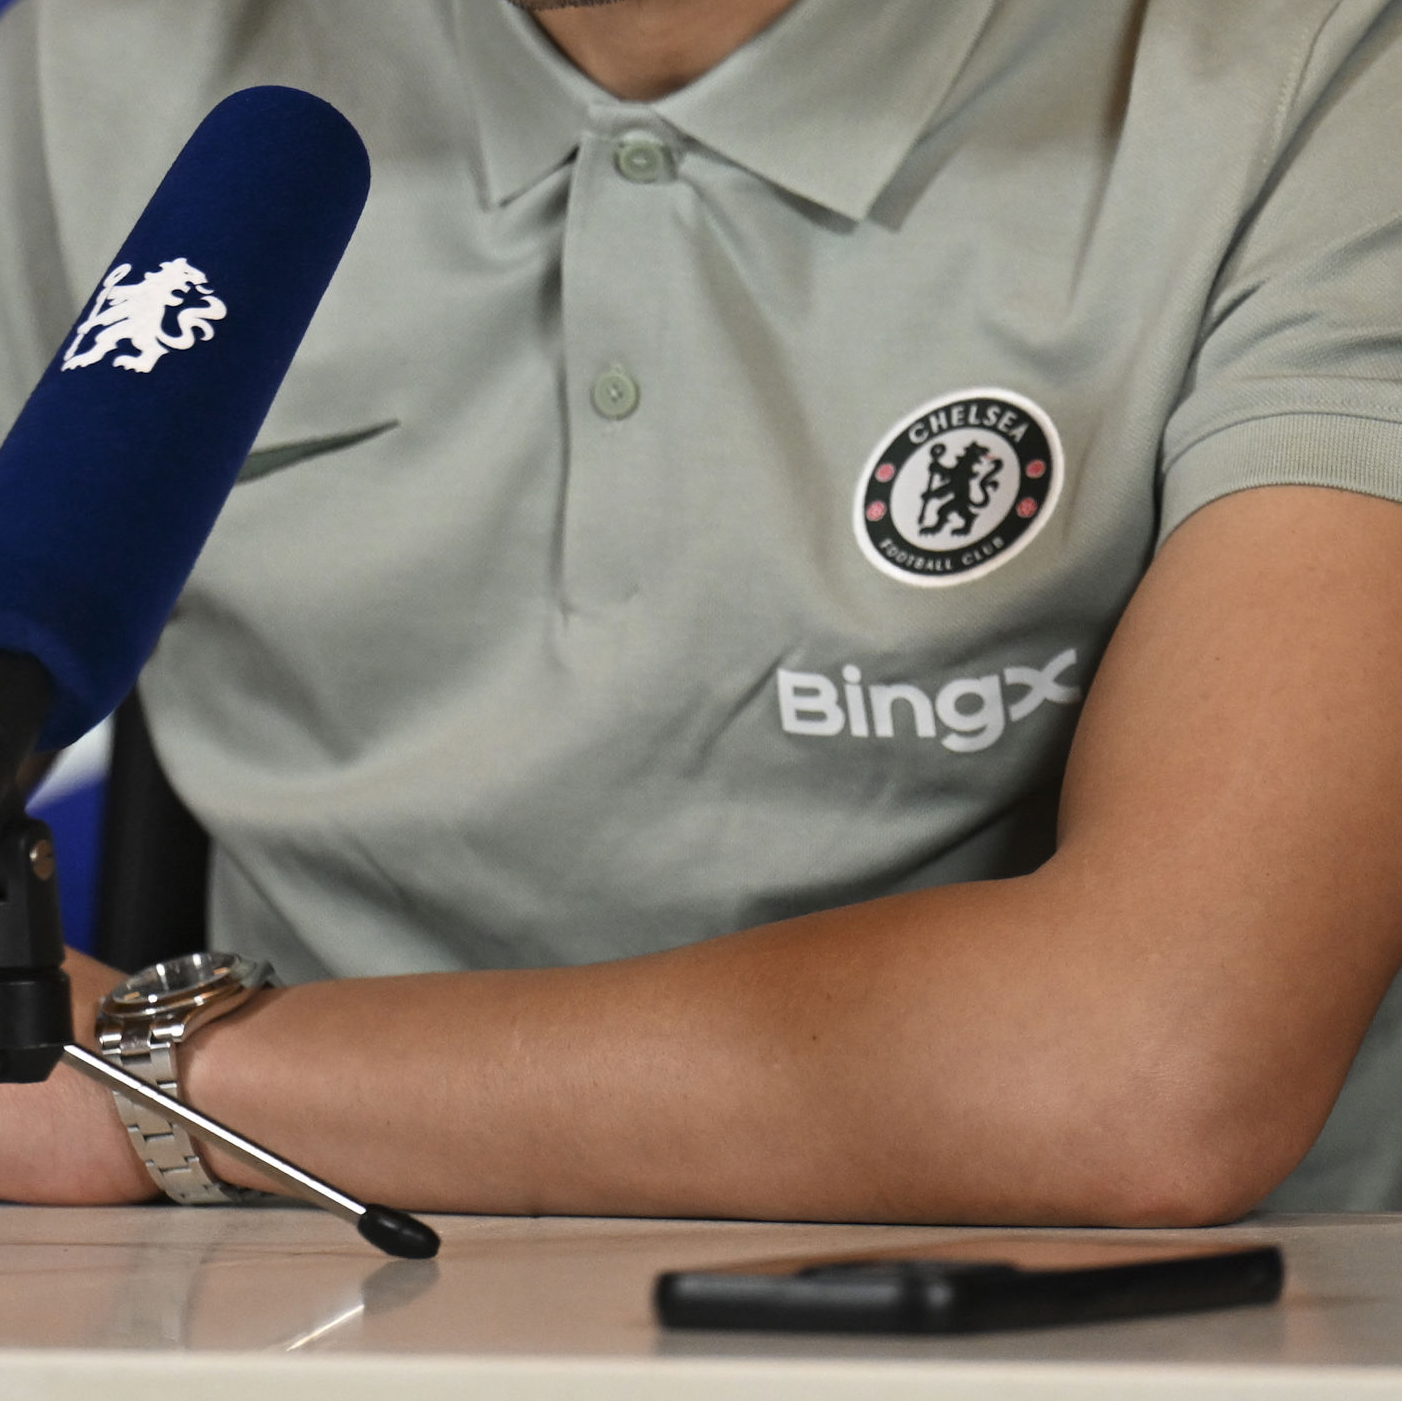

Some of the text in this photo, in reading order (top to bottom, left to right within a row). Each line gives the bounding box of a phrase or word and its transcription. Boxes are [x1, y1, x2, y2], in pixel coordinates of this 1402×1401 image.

[908, 404, 1029, 444] CHELSEA
[879, 537, 1005, 571] FOOTBALL CLUB
